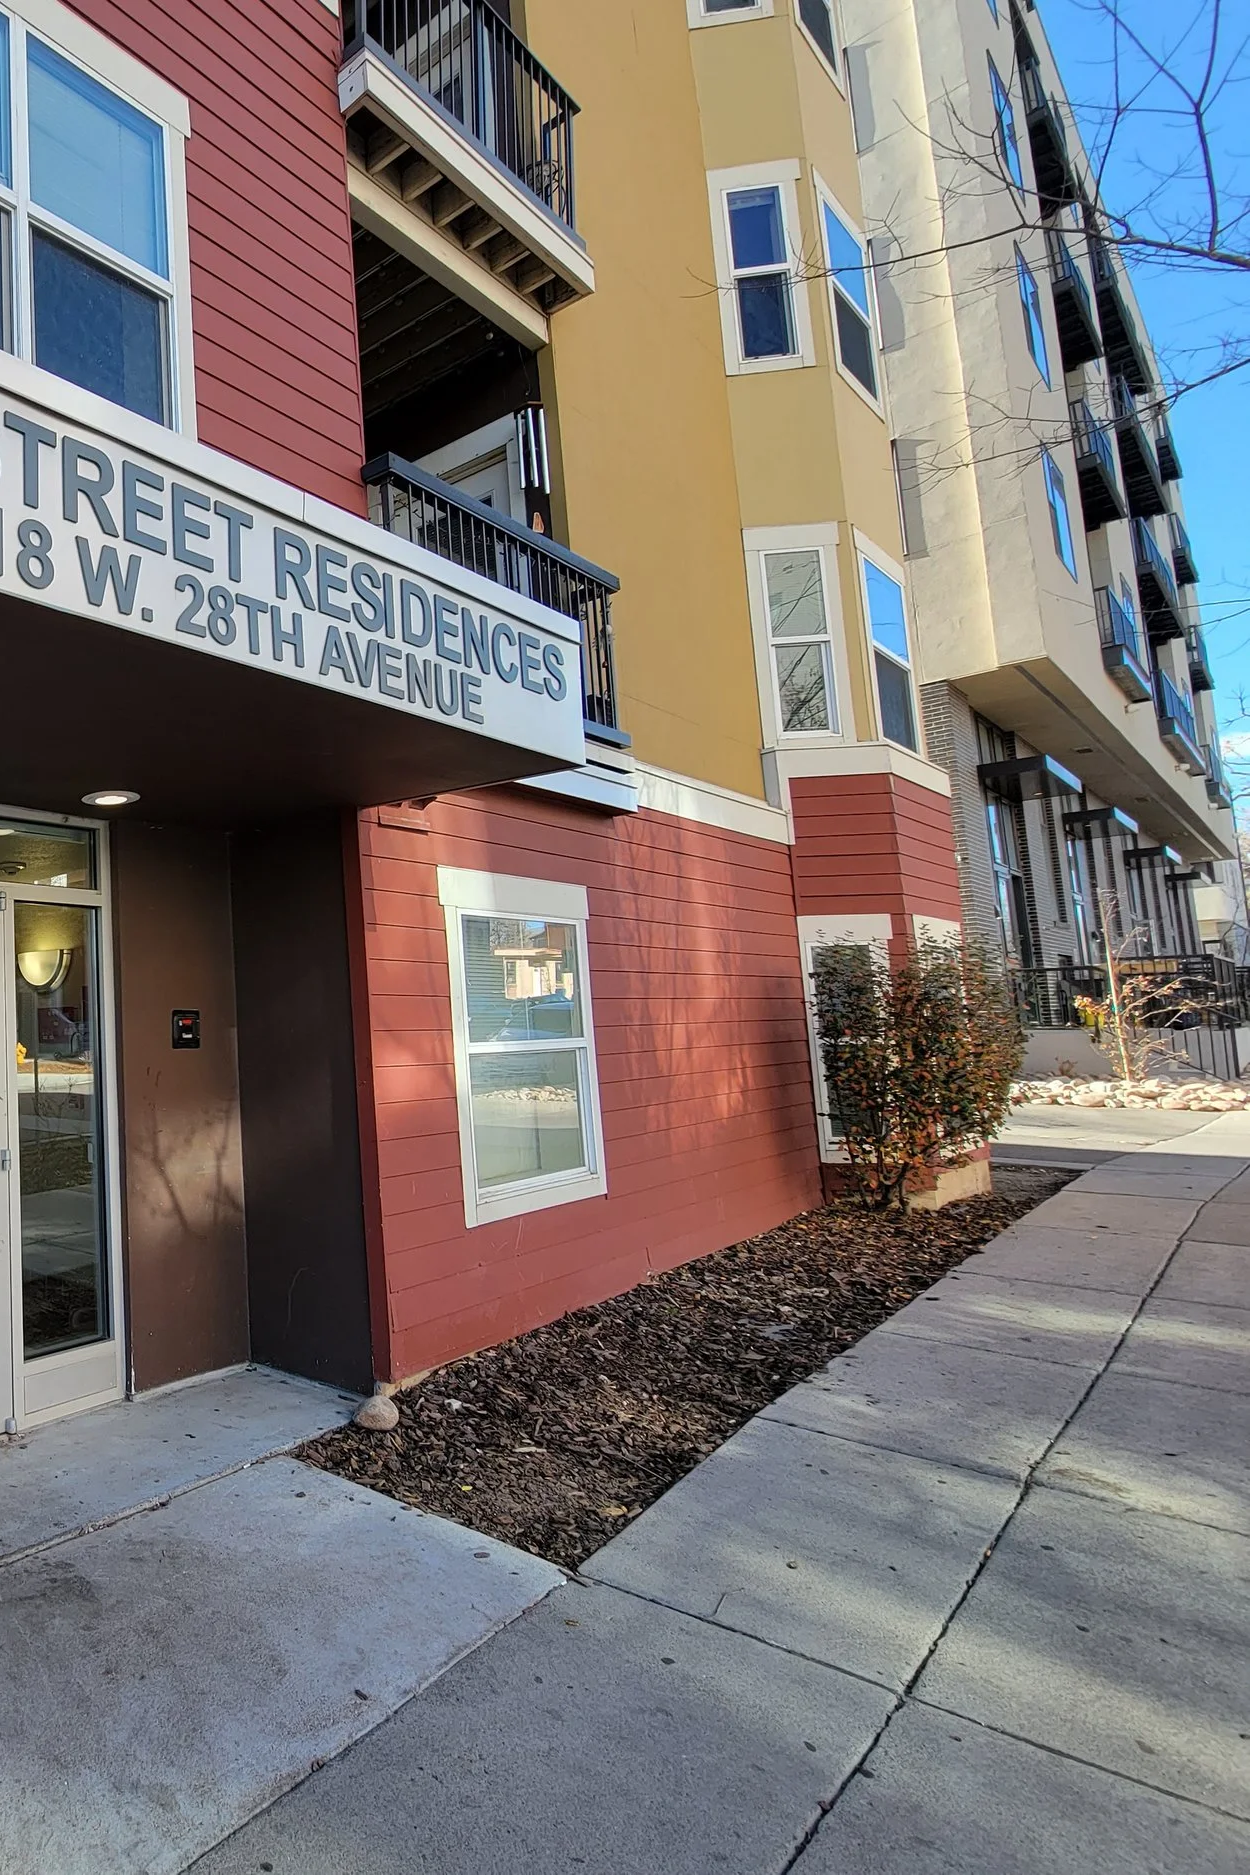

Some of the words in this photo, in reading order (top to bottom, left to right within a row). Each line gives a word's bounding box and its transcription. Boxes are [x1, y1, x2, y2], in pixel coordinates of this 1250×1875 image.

[75, 536, 154, 623] W.
[176, 574, 305, 668] 28TH
[319, 625, 484, 725] AVENUE
[274, 526, 567, 702] RESIDENCES
